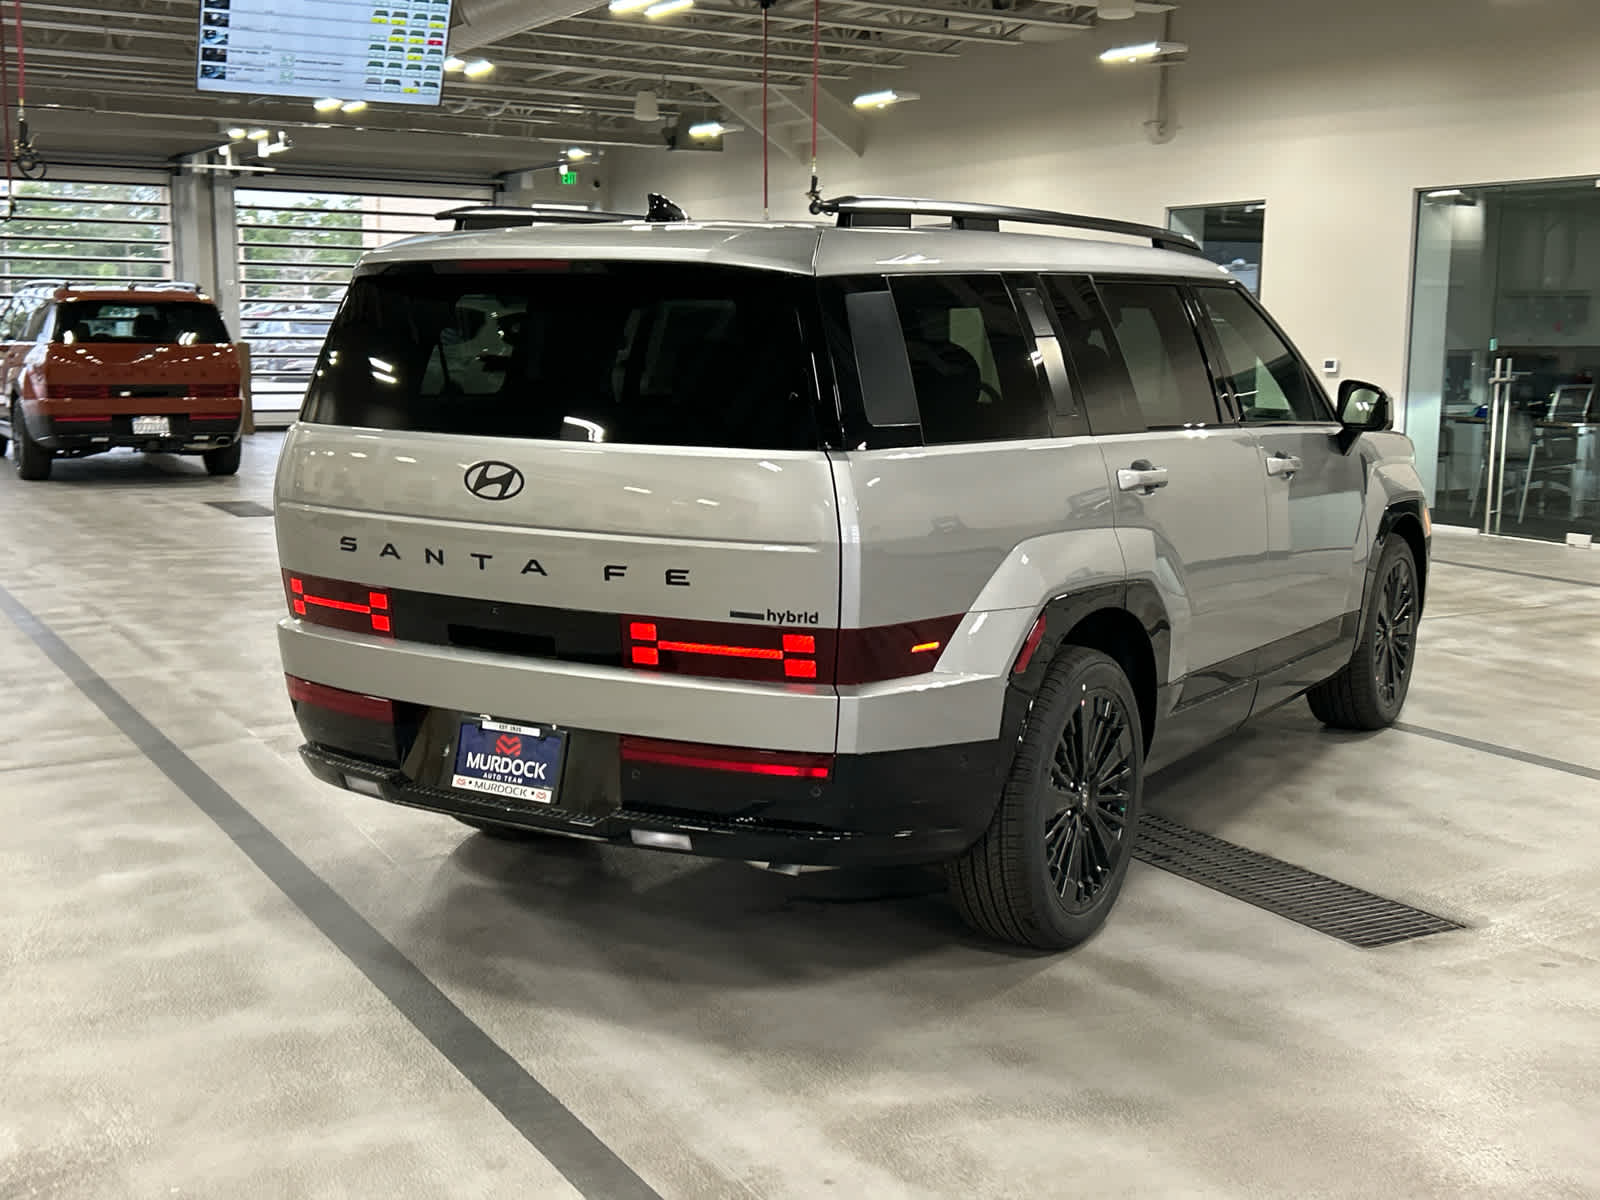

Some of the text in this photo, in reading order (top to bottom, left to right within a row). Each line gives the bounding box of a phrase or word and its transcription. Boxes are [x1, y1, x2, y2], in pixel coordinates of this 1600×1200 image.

[340, 536, 691, 587] SANTA FE
[766, 608, 819, 625] hybrid
[466, 751, 547, 780] MURDOCK
[483, 772, 523, 784] AUTO TEAM
[474, 780, 528, 797] MURDOCK
